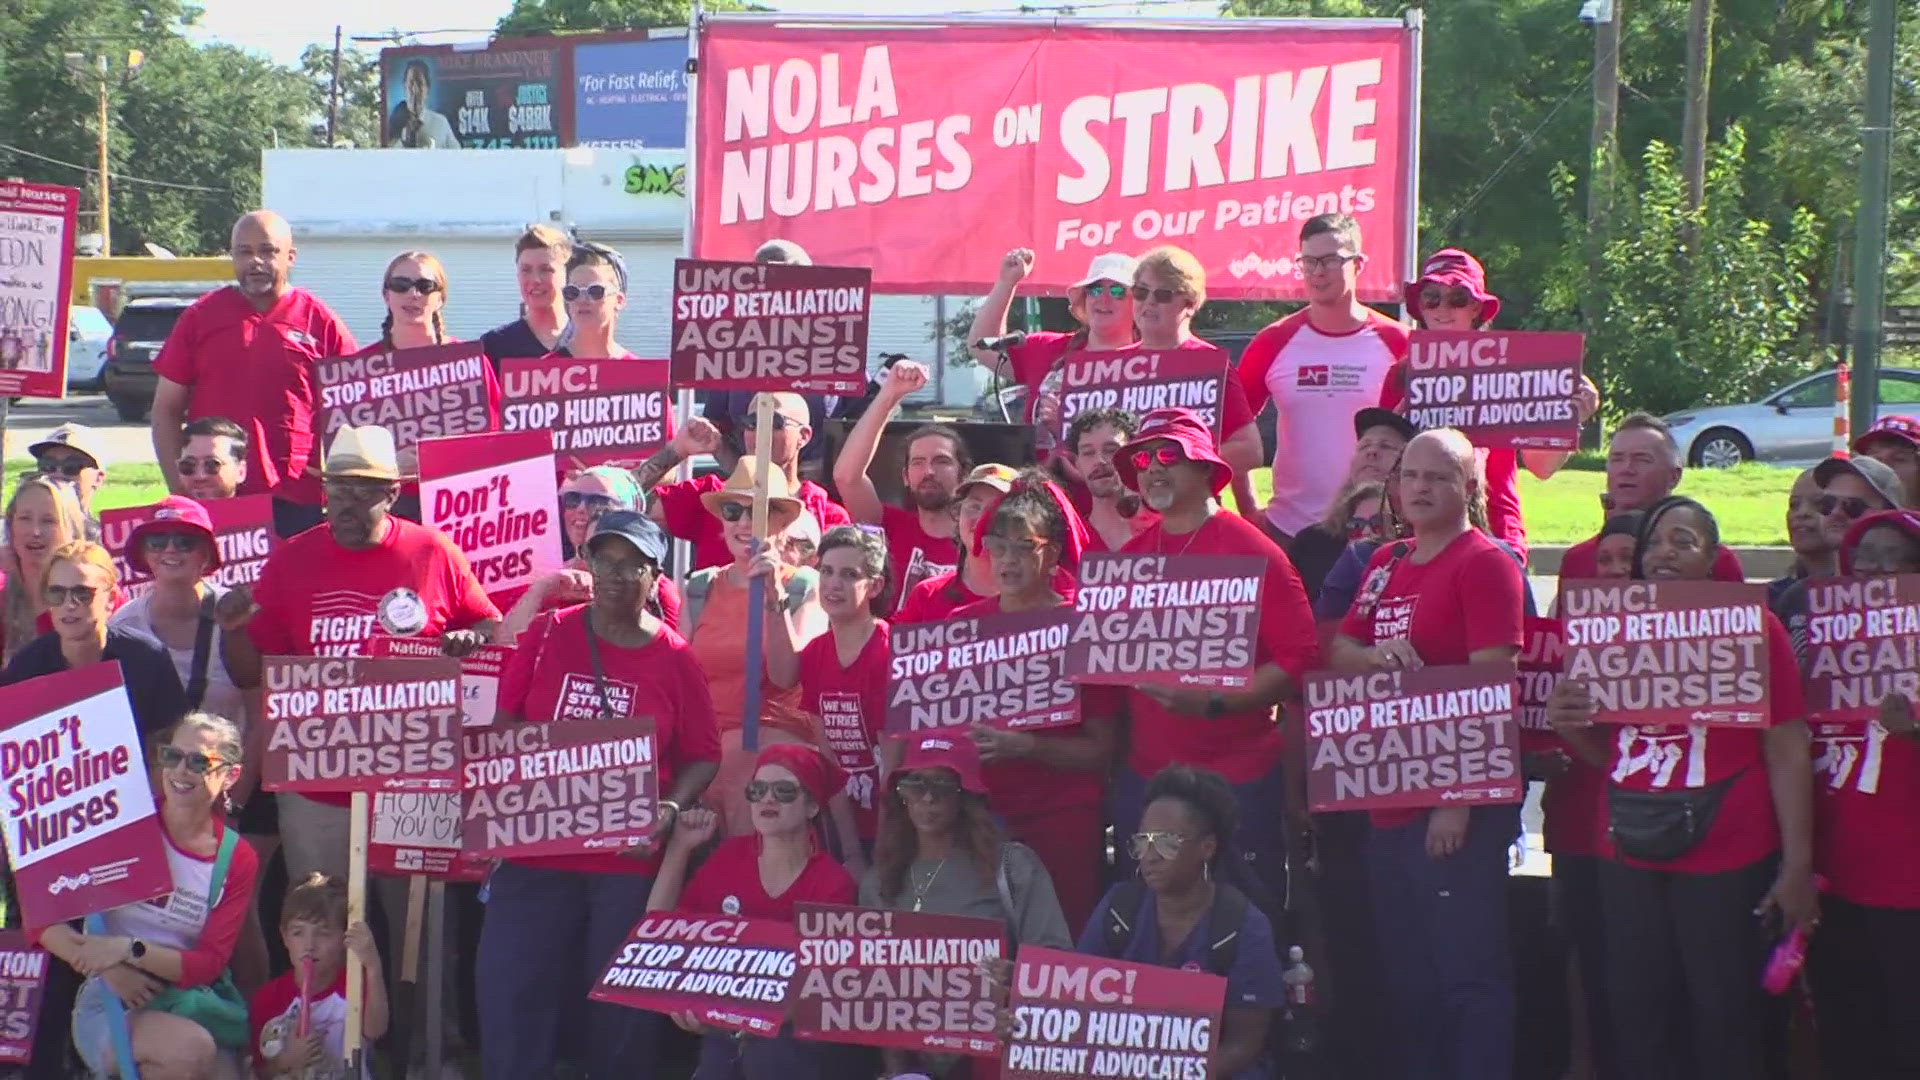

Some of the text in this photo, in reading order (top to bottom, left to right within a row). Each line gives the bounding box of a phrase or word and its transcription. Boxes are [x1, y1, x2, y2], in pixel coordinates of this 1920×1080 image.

[609, 73, 635, 90] Fast
[638, 70, 679, 91] Relief,
[724, 44, 899, 143] NOLA
[458, 106, 490, 136] $14K
[993, 104, 1041, 148] ON
[1057, 57, 1382, 204] STRIKE
[720, 114, 972, 225] NURSES
[1055, 184, 1376, 250] For Our Patients
[677, 266, 767, 293] UMC!
[0, 296, 54, 334] ONG!
[677, 287, 864, 320] STOP RETALIATION
[676, 315, 863, 352] AGAINST
[318, 352, 395, 386] UMC!
[695, 345, 860, 381] NURSES
[1066, 354, 1160, 387] UMC!
[1410, 337, 1509, 370] UMC!
[322, 356, 482, 408] STOP RETALIATION
[504, 364, 598, 398] UMC!
[1064, 379, 1218, 419] STOP HURTING
[1410, 367, 1574, 405] STOP HURTING
[326, 380, 483, 434] AGAINST
[504, 391, 662, 431] STOP HURTING
[1410, 401, 1573, 429] PATIENT ADVOCATES
[389, 406, 488, 450] RSES
[571, 421, 661, 449] ADVOCATES
[434, 474, 510, 523] Don't
[216, 527, 270, 563] TING
[471, 547, 533, 585] rses
[1081, 556, 1164, 586] UMC!
[1076, 577, 1259, 612] STOP RETALIATION
[1567, 584, 1657, 617] UMC!
[1808, 578, 1897, 614] UMC!
[311, 615, 376, 644] FIGHT
[892, 619, 978, 654] UMC!
[1071, 604, 1256, 643] AGAINST
[1568, 604, 1762, 646] STOP RETALIATION
[1810, 604, 1920, 645] STOP RETA
[892, 650, 943, 680] STOP
[1088, 638, 1249, 673] NURSES
[1569, 636, 1763, 681] AGAINST
[1811, 636, 1920, 679] AGAI
[267, 660, 355, 690] UMC!
[572, 680, 595, 693] WE
[890, 650, 1066, 707] AGAINST
[1308, 671, 1401, 708] UMC!
[1588, 671, 1764, 712] NURSES
[267, 691, 318, 720] STOP
[324, 679, 456, 714] RETALIATION
[564, 705, 593, 718] FOR
[568, 692, 630, 713] STRKE
[823, 700, 839, 712] WE
[911, 681, 1076, 731] NURSES
[1310, 684, 1511, 737] STOP RETALIATION
[268, 707, 456, 751] AGAINST
[823, 714, 859, 727] STRIKE
[2, 714, 82, 779] Don't
[463, 723, 549, 760] UMC!
[1312, 713, 1512, 771] AGAINST
[288, 741, 455, 781] NURSES
[464, 736, 651, 789] STOP RETALIATION
[1335, 747, 1514, 800] NURSES
[8, 744, 129, 817] Sideline
[465, 765, 652, 821] AGAINST
[20, 789, 119, 856] Nurses
[391, 815, 426, 840] YOU
[487, 797, 652, 849] NURSES
[637, 918, 749, 943] UMC!
[800, 911, 893, 938] UMC!
[616, 942, 796, 976] STOP HURTING
[800, 938, 1000, 966] STOP RETALIATION
[603, 967, 789, 1003] PATIENT ADVOCATES
[801, 966, 993, 1000] AGAINST
[1018, 962, 1137, 1005] UMC!
[821, 1000, 997, 1032] NURSES
[1012, 1006, 1210, 1052] STOP HURTING
[1008, 1044, 1088, 1074] PATIENT
[1092, 1051, 1208, 1080] ADVOCATES
